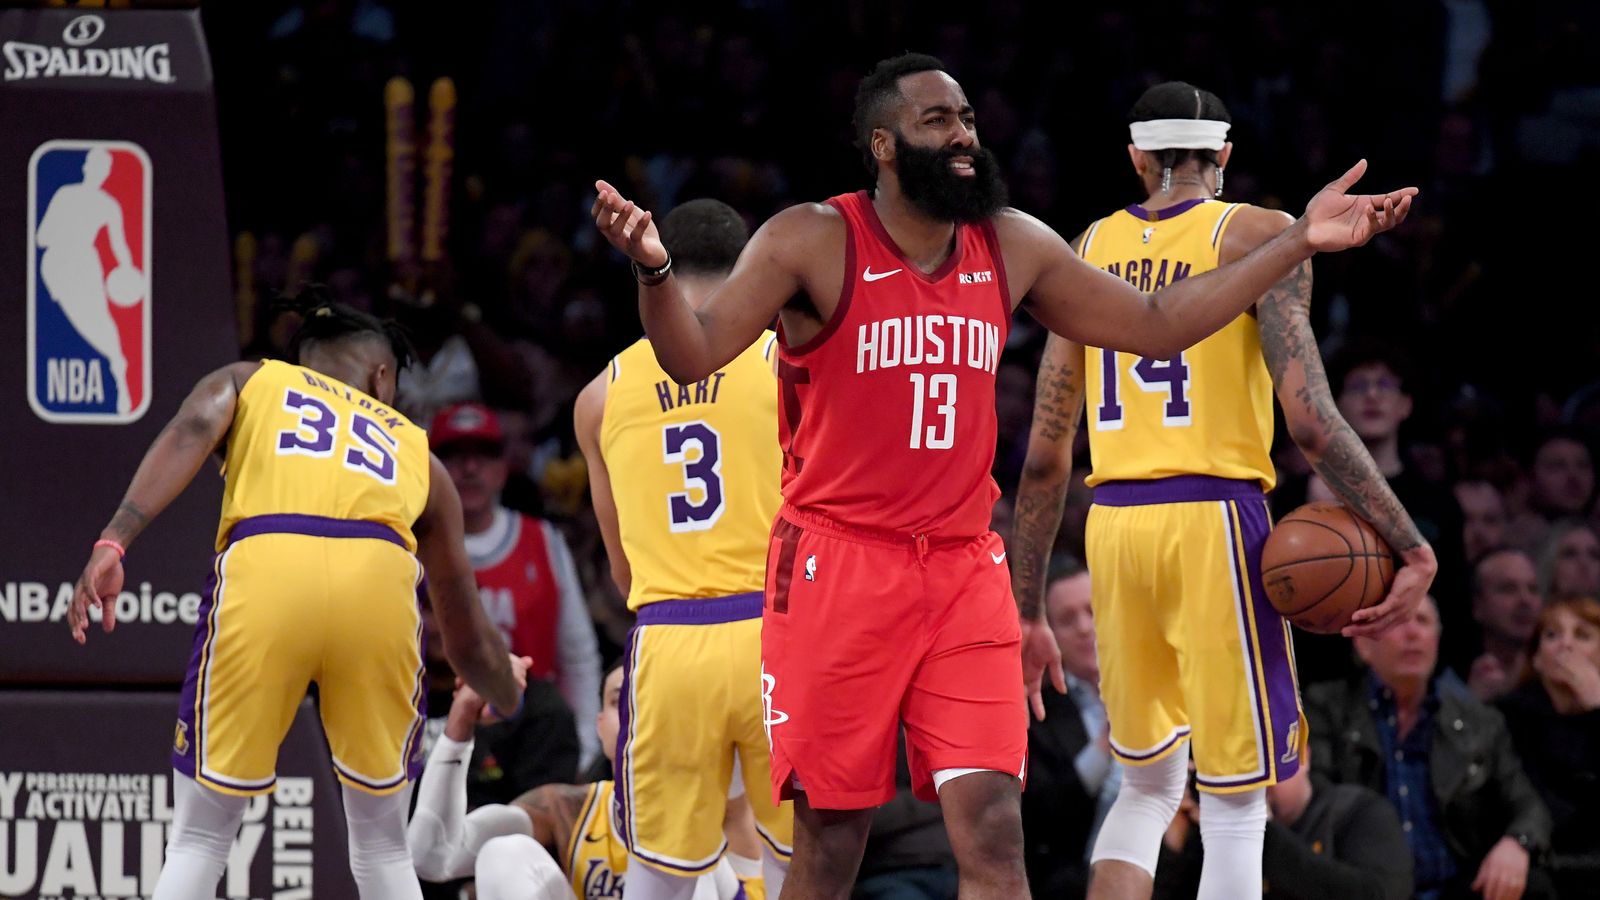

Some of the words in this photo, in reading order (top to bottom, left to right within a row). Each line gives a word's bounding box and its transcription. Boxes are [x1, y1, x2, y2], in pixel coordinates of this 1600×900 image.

[3, 41, 170, 83] SPALDING
[857, 315, 999, 375] HOUSTON
[47, 358, 104, 404] NBA
[655, 373, 725, 412] HART
[1096, 348, 1192, 431] 14
[275, 388, 397, 486] 35
[910, 373, 957, 449] 13
[662, 420, 725, 533] 3
[26, 773, 149, 792] PERSEVERANCE
[26, 792, 150, 820] ACTIVATE
